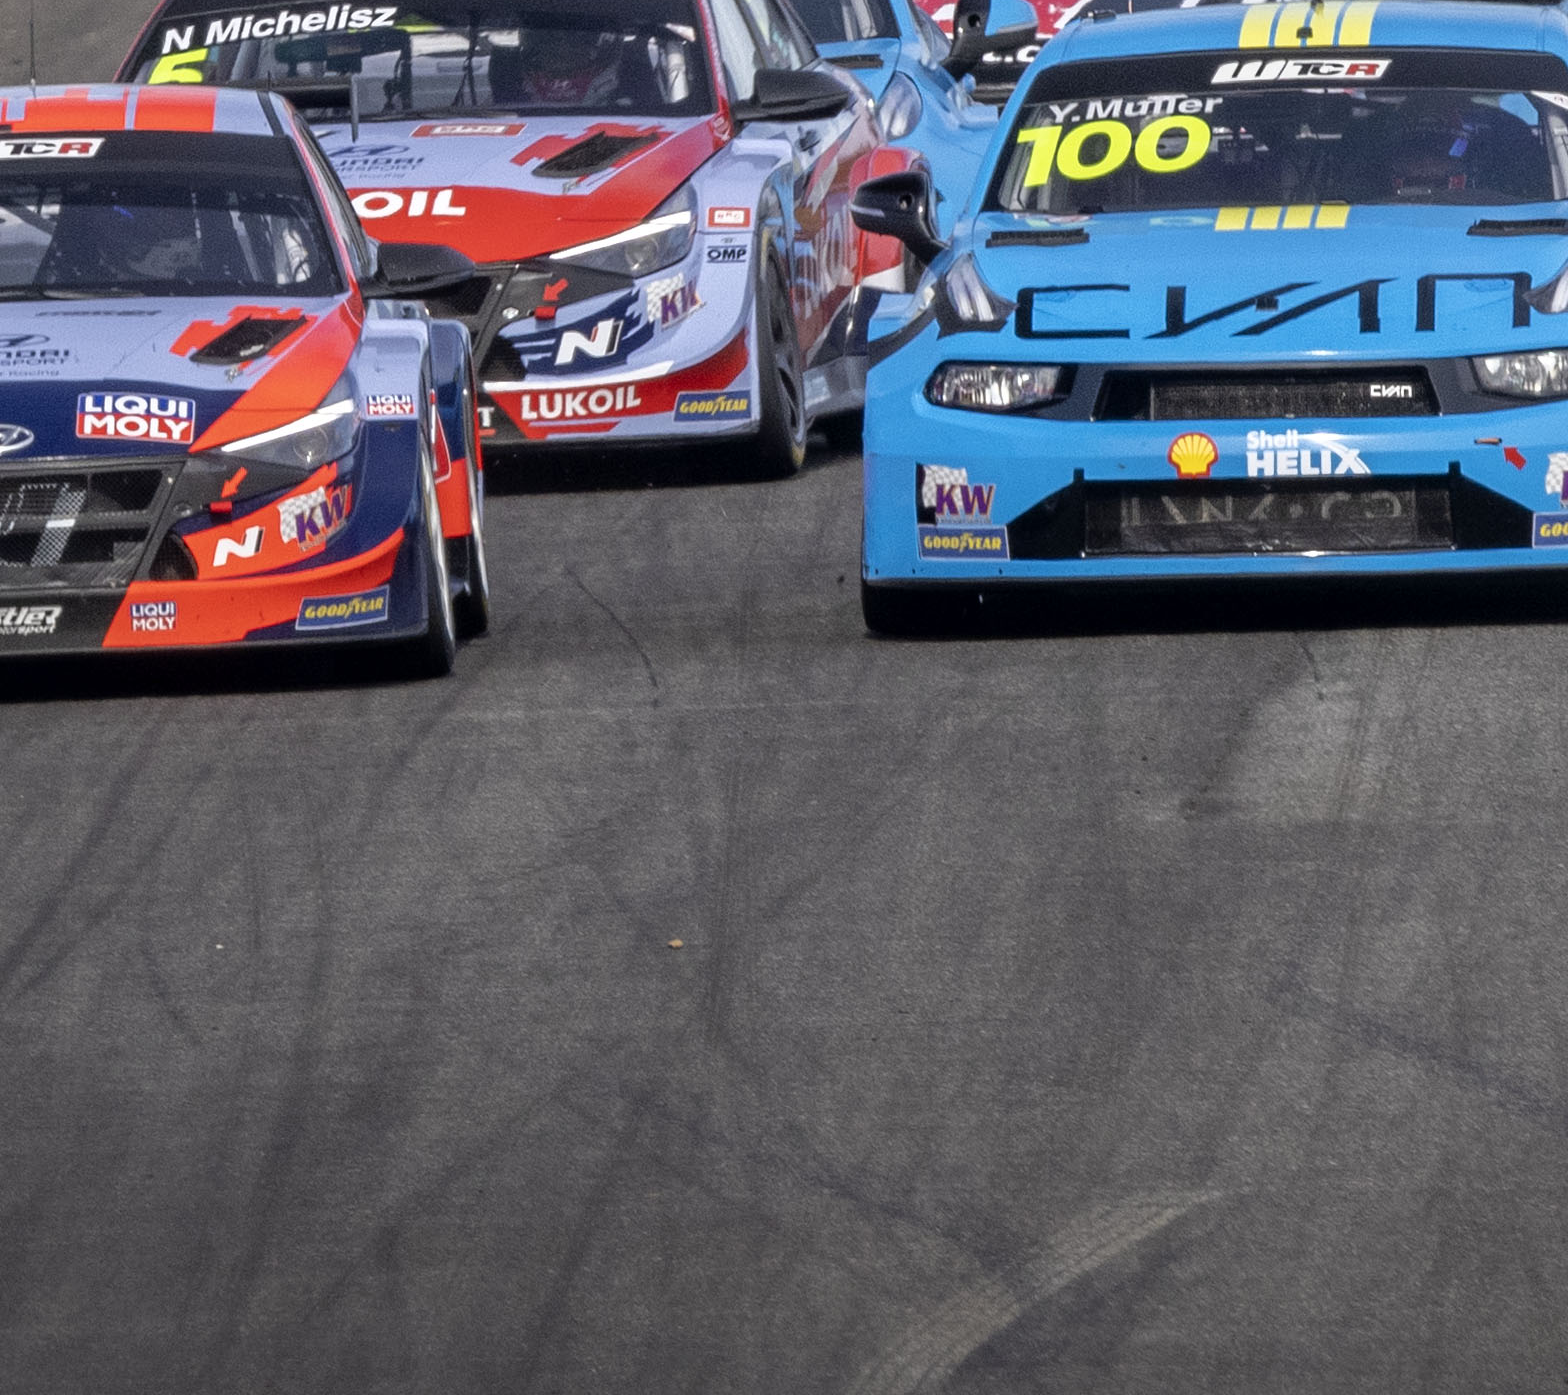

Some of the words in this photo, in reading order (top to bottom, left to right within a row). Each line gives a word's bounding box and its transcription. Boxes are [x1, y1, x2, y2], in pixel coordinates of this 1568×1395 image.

[162, 26, 198, 57] N
[204, 3, 399, 45] Michelisz
[1209, 58, 1393, 86] WTCR
[1016, 115, 1212, 188] 100
[707, 246, 748, 262] OMP
[84, 395, 190, 419] LIQUI
[367, 395, 413, 406] LIQUI
[367, 403, 414, 415] MOLY
[520, 384, 643, 421] LUKOIL
[678, 395, 750, 417] GOODYEAR
[83, 414, 192, 440] MOLY
[1246, 430, 1300, 451] Shell
[1246, 447, 1374, 477] HELIX
[934, 483, 997, 517] KW
[296, 488, 349, 545] KW
[923, 531, 1004, 555] GOODYEAR
[131, 601, 177, 617] LIQUI
[304, 595, 386, 620] GOODYEAR
[131, 616, 177, 632] MOLY
